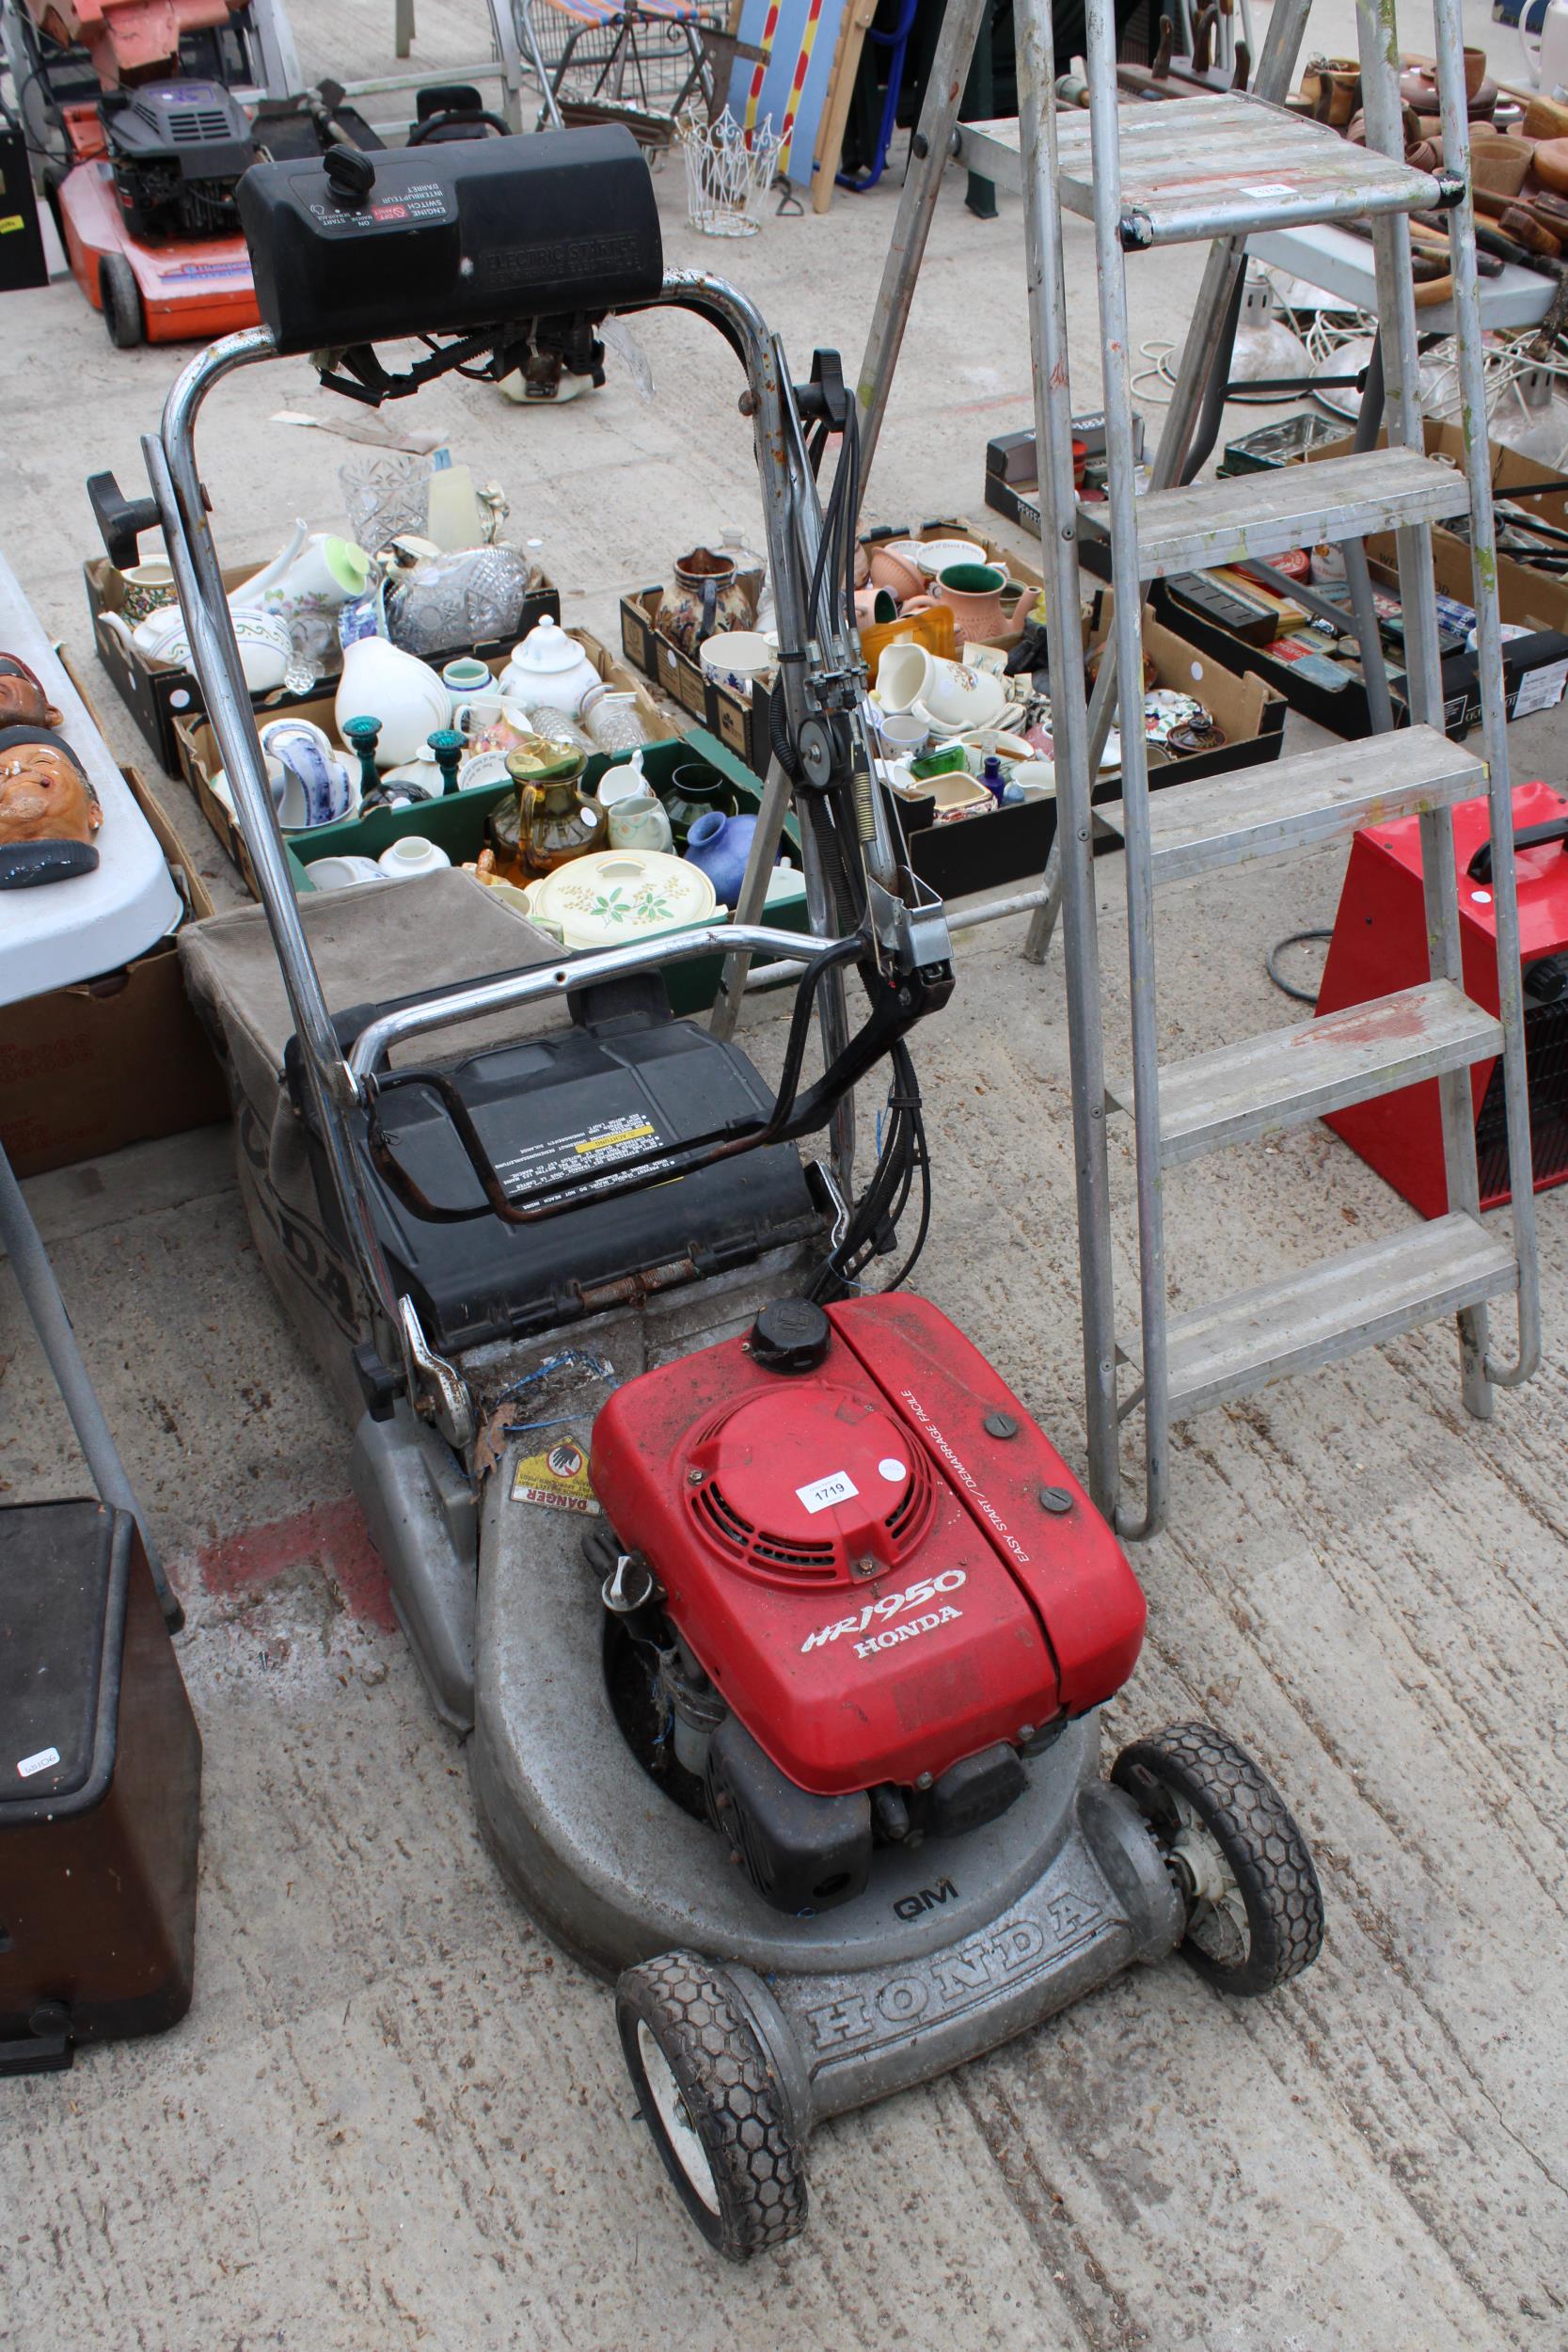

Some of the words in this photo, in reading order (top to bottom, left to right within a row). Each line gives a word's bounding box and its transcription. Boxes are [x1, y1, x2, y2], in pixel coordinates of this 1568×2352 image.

[383, 191, 442, 202] INTERRUPTEUR
[408, 200, 441, 209] SWITCH
[412, 207, 445, 216] ENGINE
[487, 246, 563, 269] ELECTRIC
[595, 1135, 626, 1146] ACHTUNG
[535, 1166, 556, 1174] METTRE
[638, 1166, 658, 1174] PREVENT
[900, 1390, 932, 1422] FACILE
[527, 1489, 587, 1510] DANGER
[815, 1483, 846, 1502] 1719
[1003, 1534, 1029, 1563] EASY
[800, 1569, 967, 1654] HR1950
[853, 1604, 962, 1660] HONDA
[893, 1879, 959, 1920] QM
[808, 1892, 1102, 2050] HONDA
